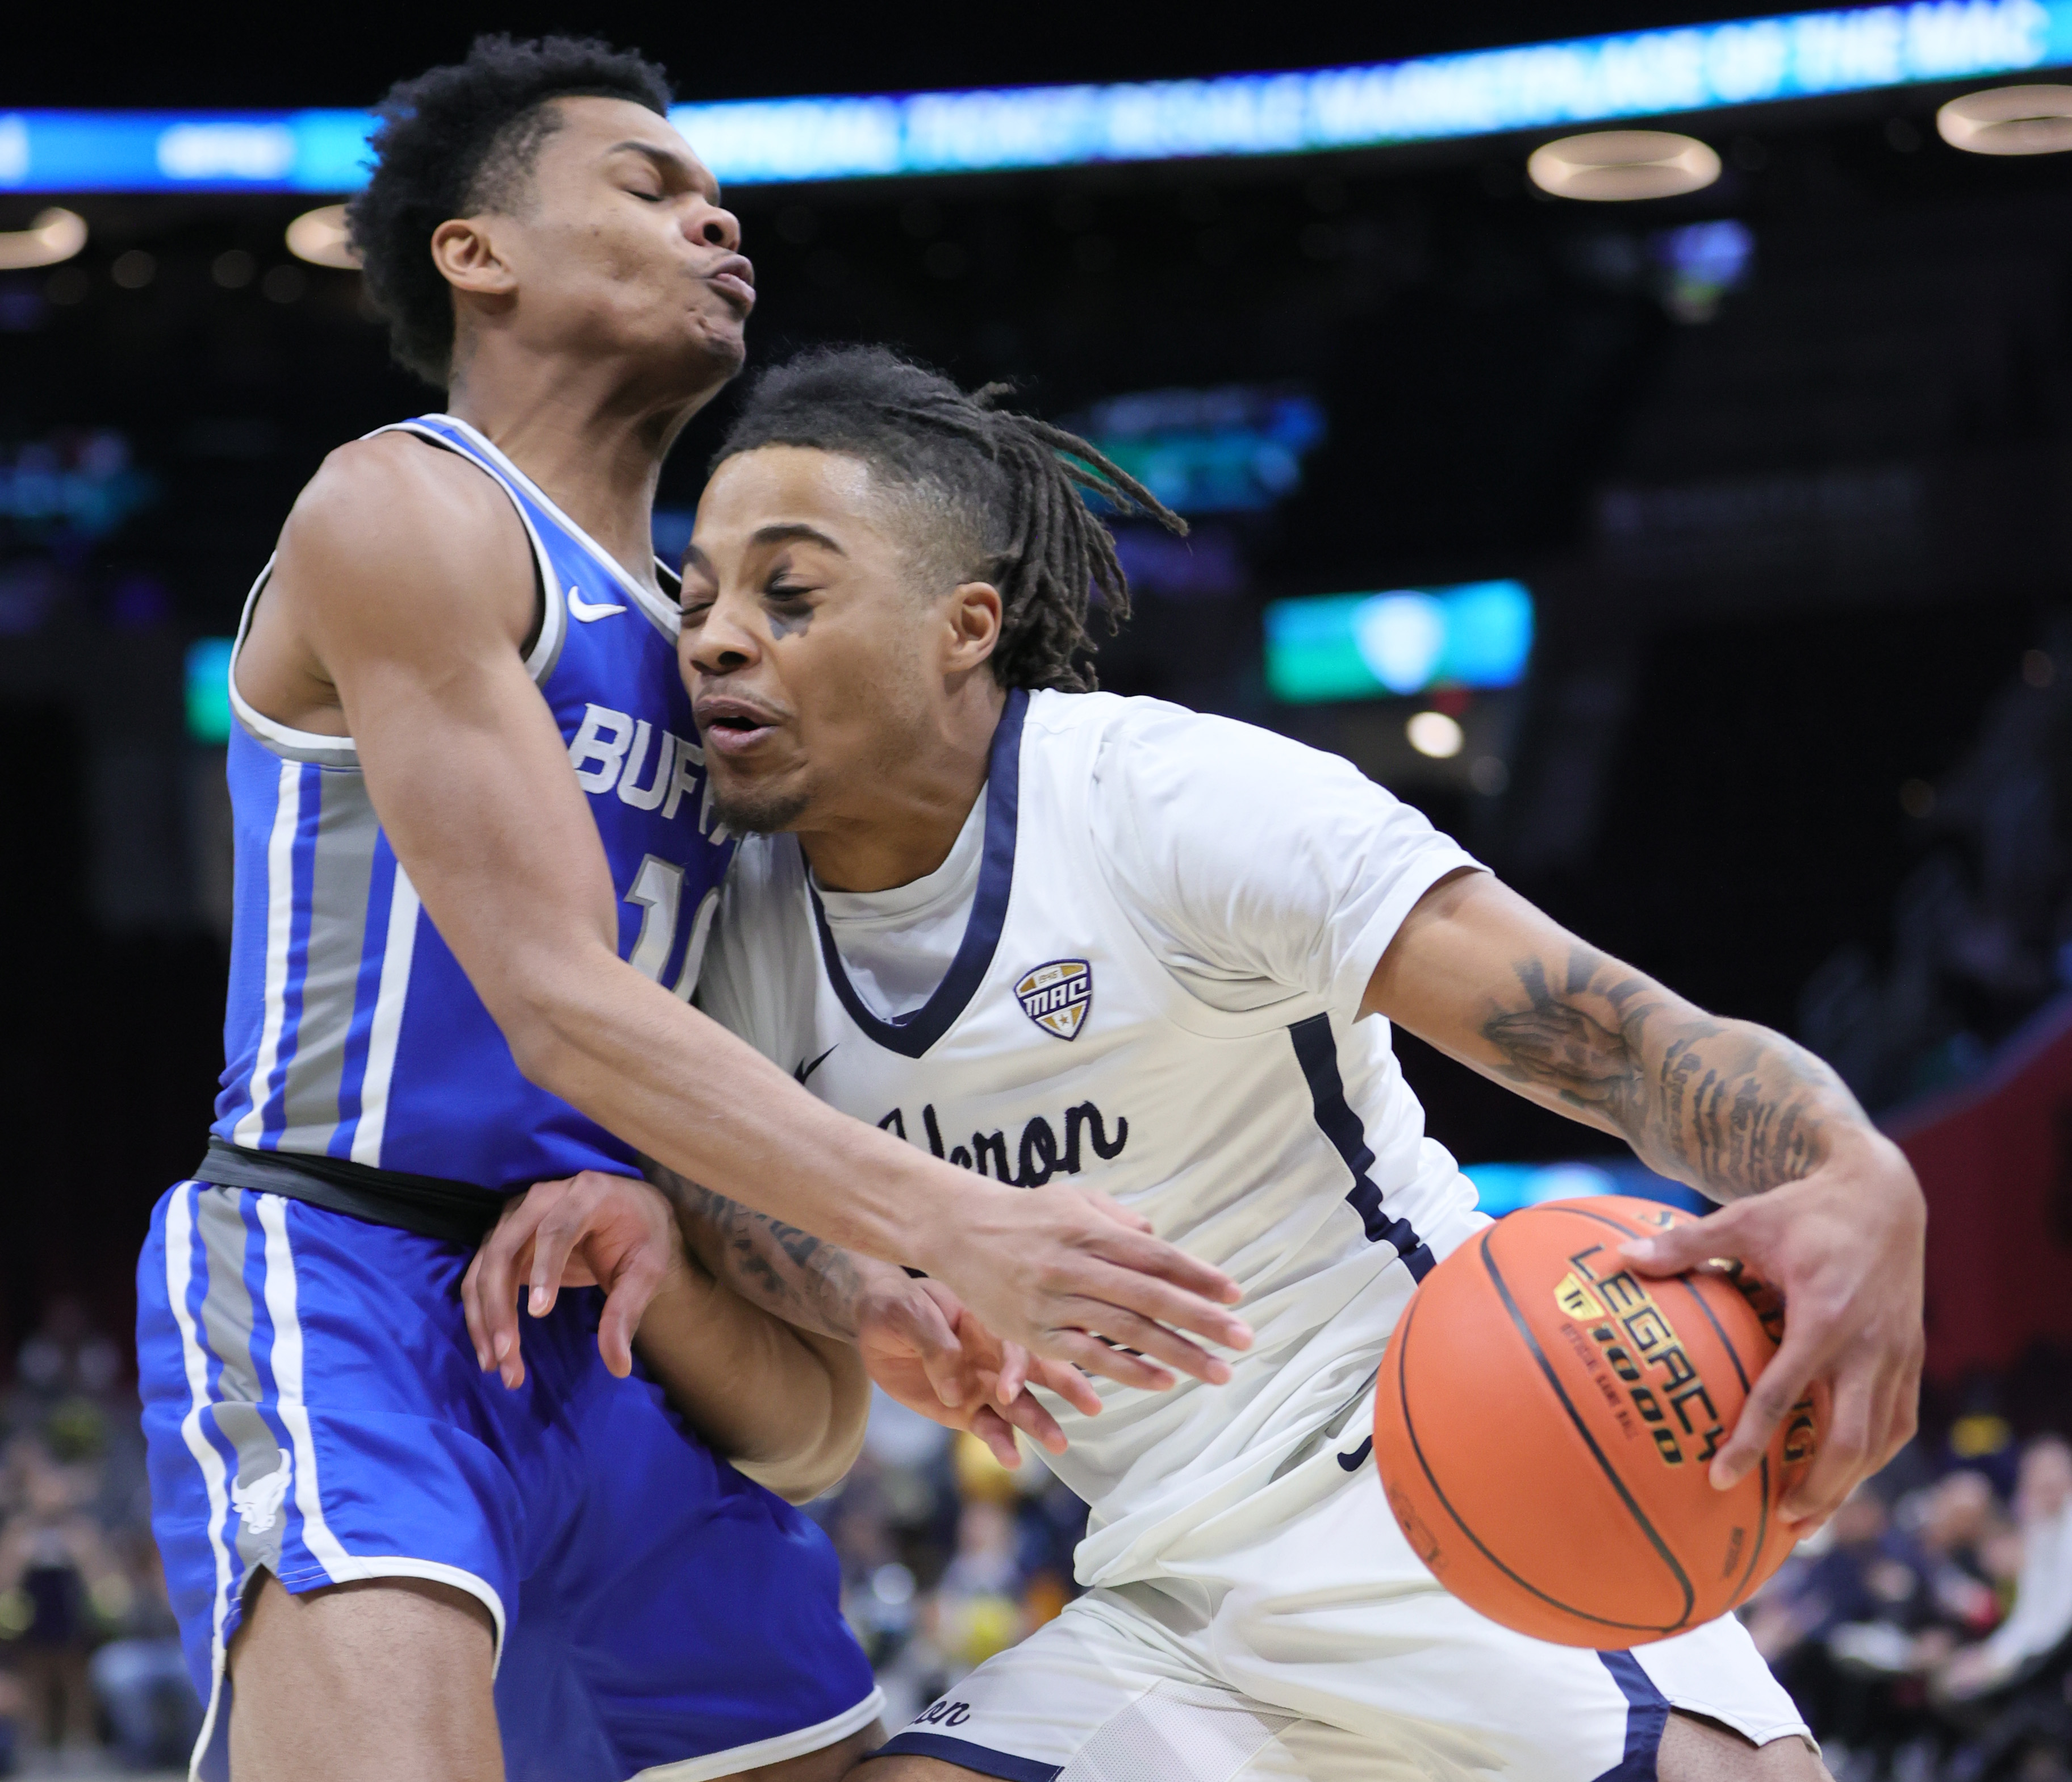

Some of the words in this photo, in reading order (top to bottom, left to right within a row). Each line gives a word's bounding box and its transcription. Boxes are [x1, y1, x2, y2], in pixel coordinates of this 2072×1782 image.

[1022, 976, 1092, 1017] MAC
[1569, 1243, 1724, 1463] LEGACY
[1589, 1322, 1685, 1467] 1000
